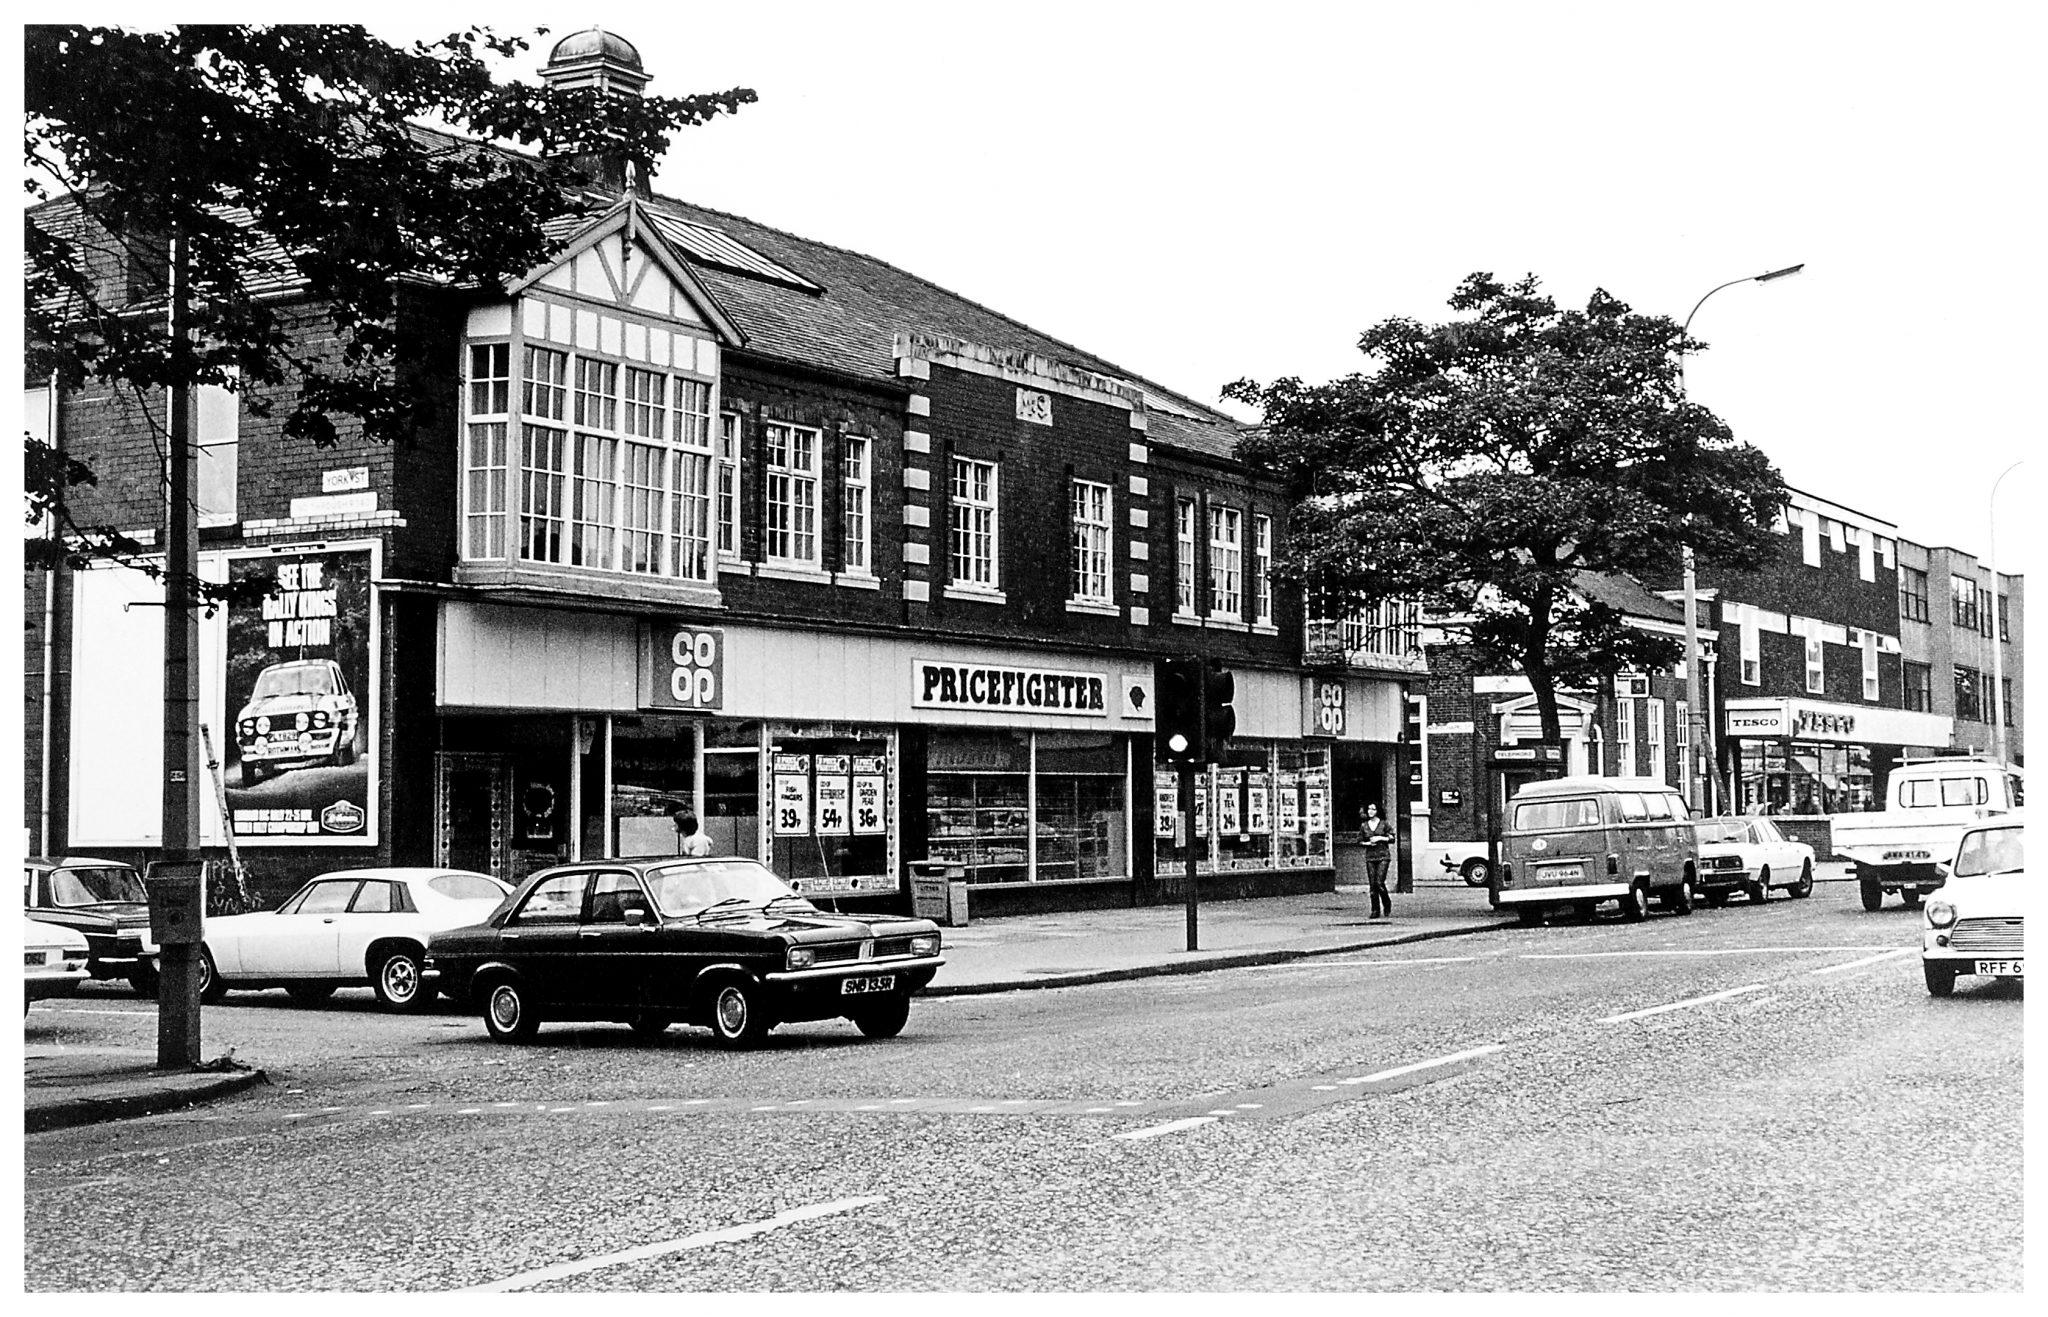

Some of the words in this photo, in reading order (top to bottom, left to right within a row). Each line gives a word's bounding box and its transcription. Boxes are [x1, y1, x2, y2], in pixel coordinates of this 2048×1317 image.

[327, 474, 350, 486] YORK
[277, 563, 300, 590] SEE
[300, 562, 323, 589] THE
[298, 588, 337, 617] KINGS
[268, 620, 283, 647] IN
[285, 618, 331, 647] ACTION
[922, 665, 1104, 710] PRICEFIGHTER
[1732, 719, 1779, 727] TESCO
[1798, 709, 1855, 734] TESCO
[781, 793, 803, 801] FINGERS
[860, 789, 878, 797] GARDEN
[822, 809, 842, 828] 54p
[858, 808, 878, 827] 36p
[1979, 962, 2007, 974] RFF
[2012, 961, 2024, 974] 6
